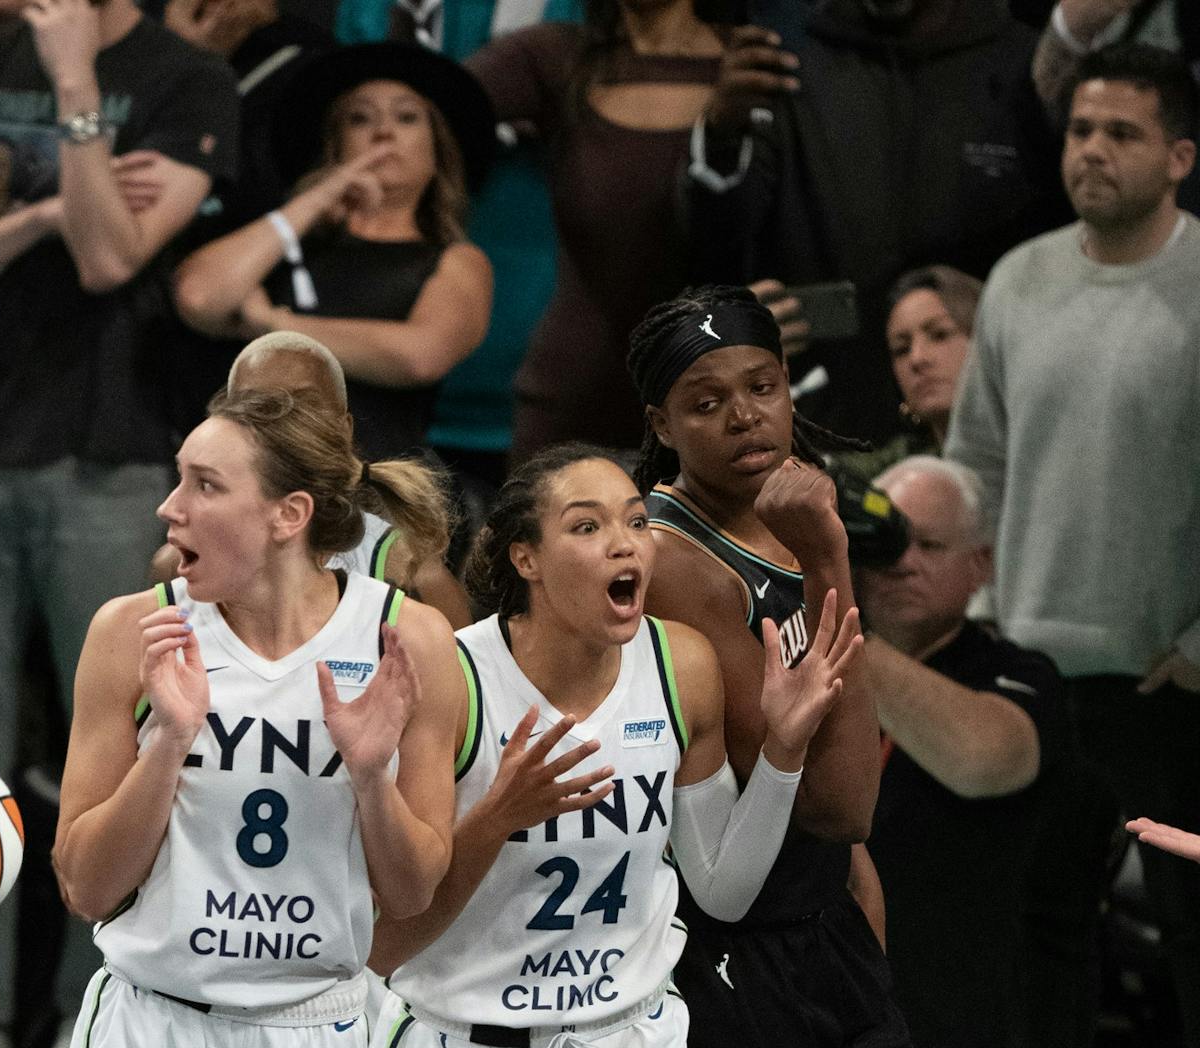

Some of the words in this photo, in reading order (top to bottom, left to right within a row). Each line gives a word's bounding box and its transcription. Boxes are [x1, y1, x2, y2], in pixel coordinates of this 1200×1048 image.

[779, 608, 808, 669] EW
[183, 711, 344, 777] YN
[624, 720, 666, 733] FEDERATED
[236, 788, 289, 868] 8
[506, 770, 668, 843] NX
[205, 889, 315, 924] MAYO
[526, 851, 631, 931] 24
[189, 927, 322, 960] CLINIC
